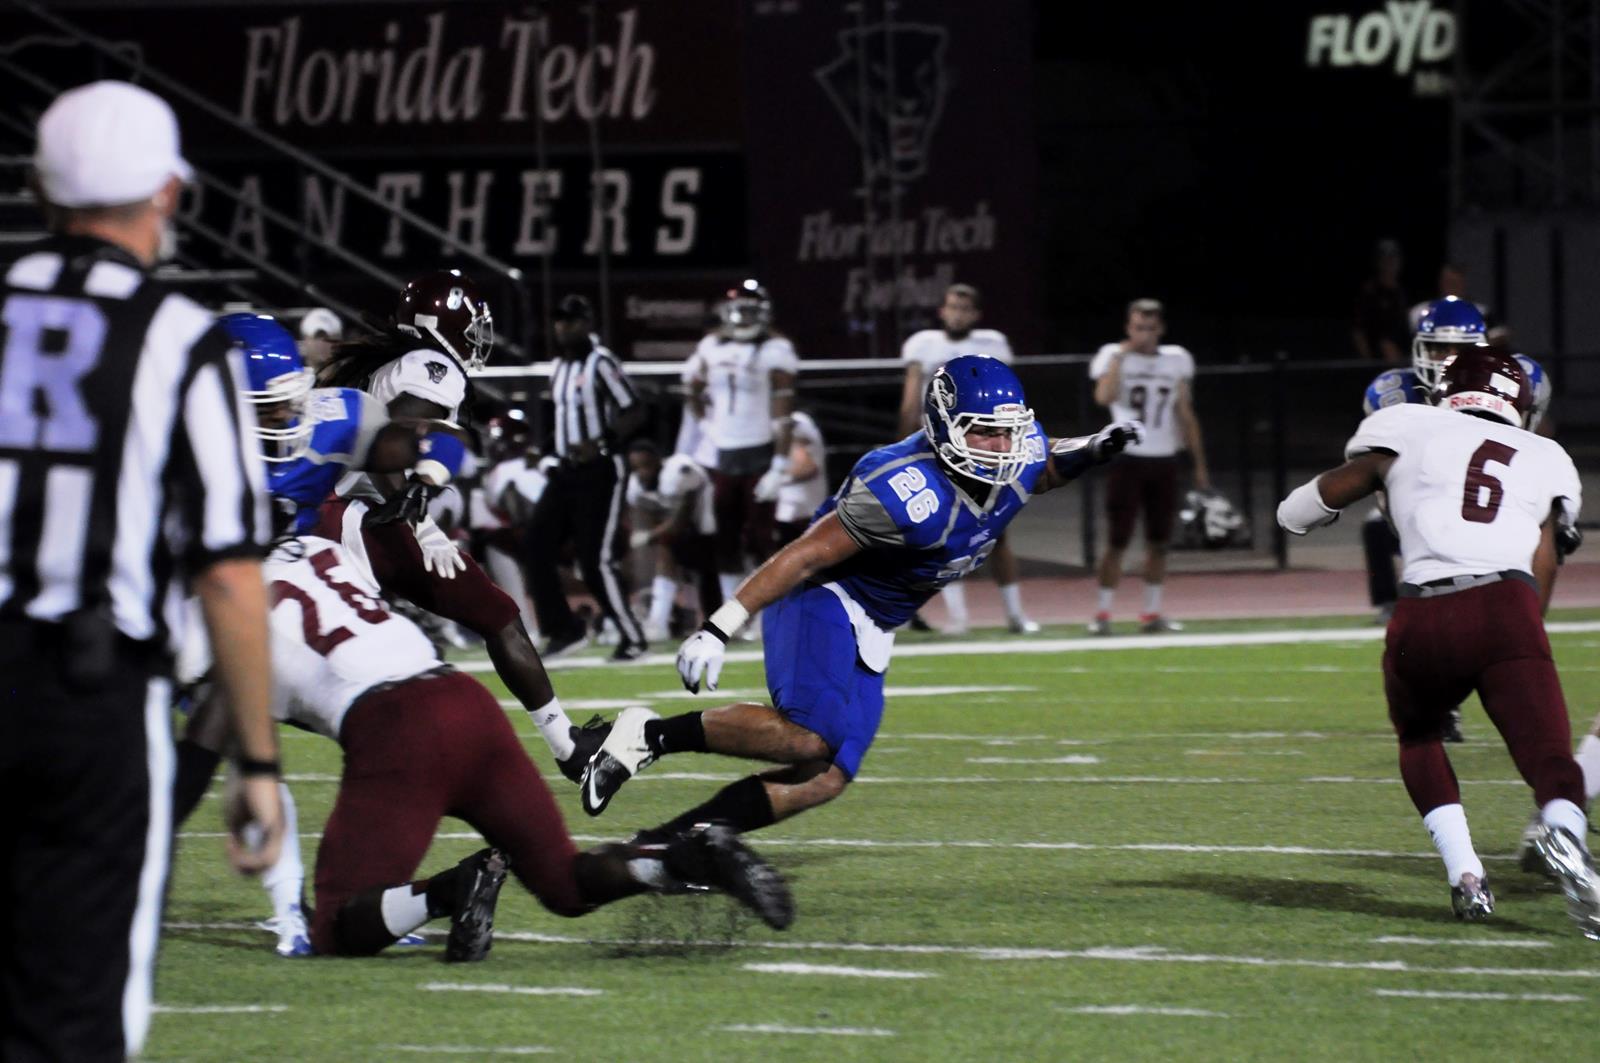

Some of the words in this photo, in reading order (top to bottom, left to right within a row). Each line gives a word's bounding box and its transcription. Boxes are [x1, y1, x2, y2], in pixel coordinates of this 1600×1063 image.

[240, 14, 487, 127] Florida
[499, 8, 659, 123] Tech
[1306, 0, 1456, 75] FLOYD
[922, 198, 997, 253] Tech
[446, 287, 464, 311] 8
[0, 292, 110, 453] R
[1129, 385, 1171, 429] 97
[887, 466, 940, 524] 26
[1461, 438, 1519, 524] 6
[269, 547, 392, 657] 26
